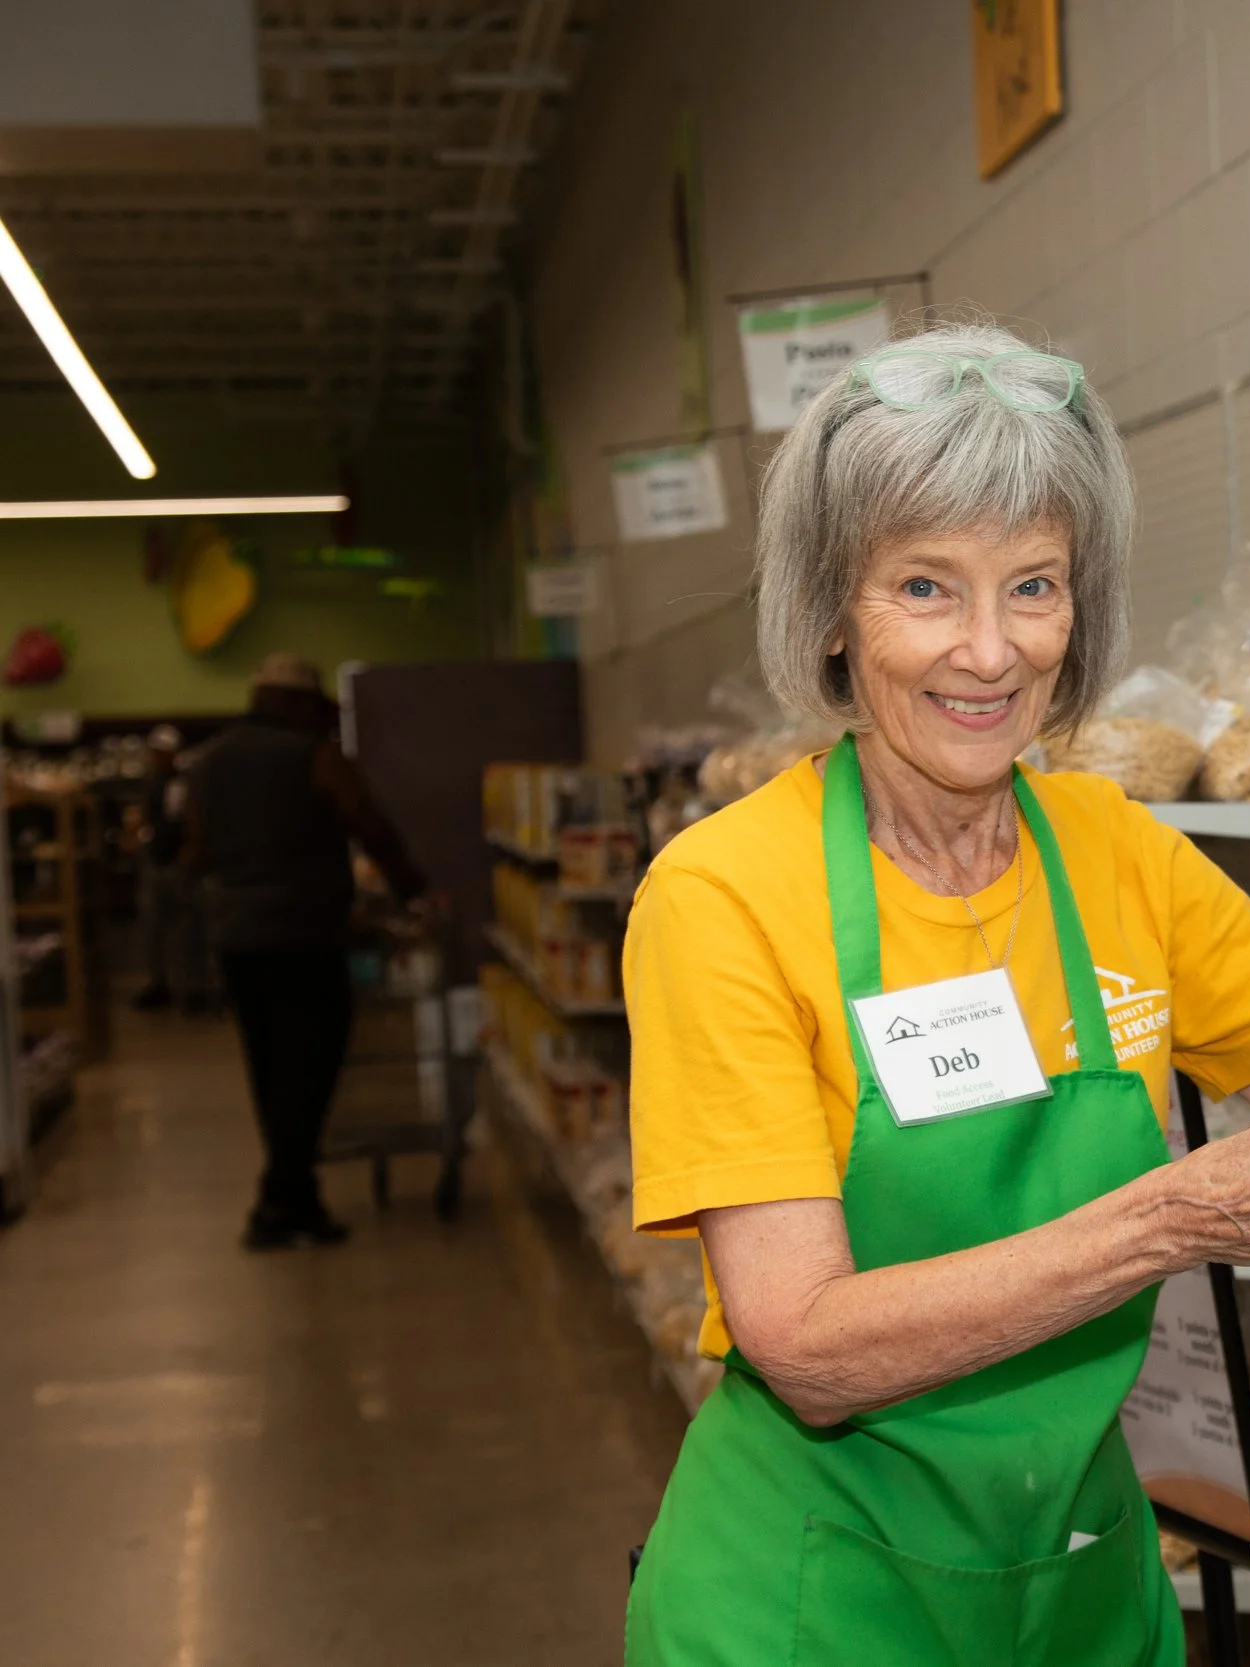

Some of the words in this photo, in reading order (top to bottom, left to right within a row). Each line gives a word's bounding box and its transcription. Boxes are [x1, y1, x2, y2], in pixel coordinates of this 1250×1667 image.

[930, 1014, 968, 1031] ACTION
[970, 1005, 1006, 1022] HOUSE
[939, 1000, 988, 1018] COMMUNITY
[928, 1047, 981, 1078] Deb
[933, 1096, 982, 1114] Volunteer
[982, 1090, 1006, 1105] Lead
[935, 1085, 963, 1100] Food
[963, 1080, 994, 1096] Access
